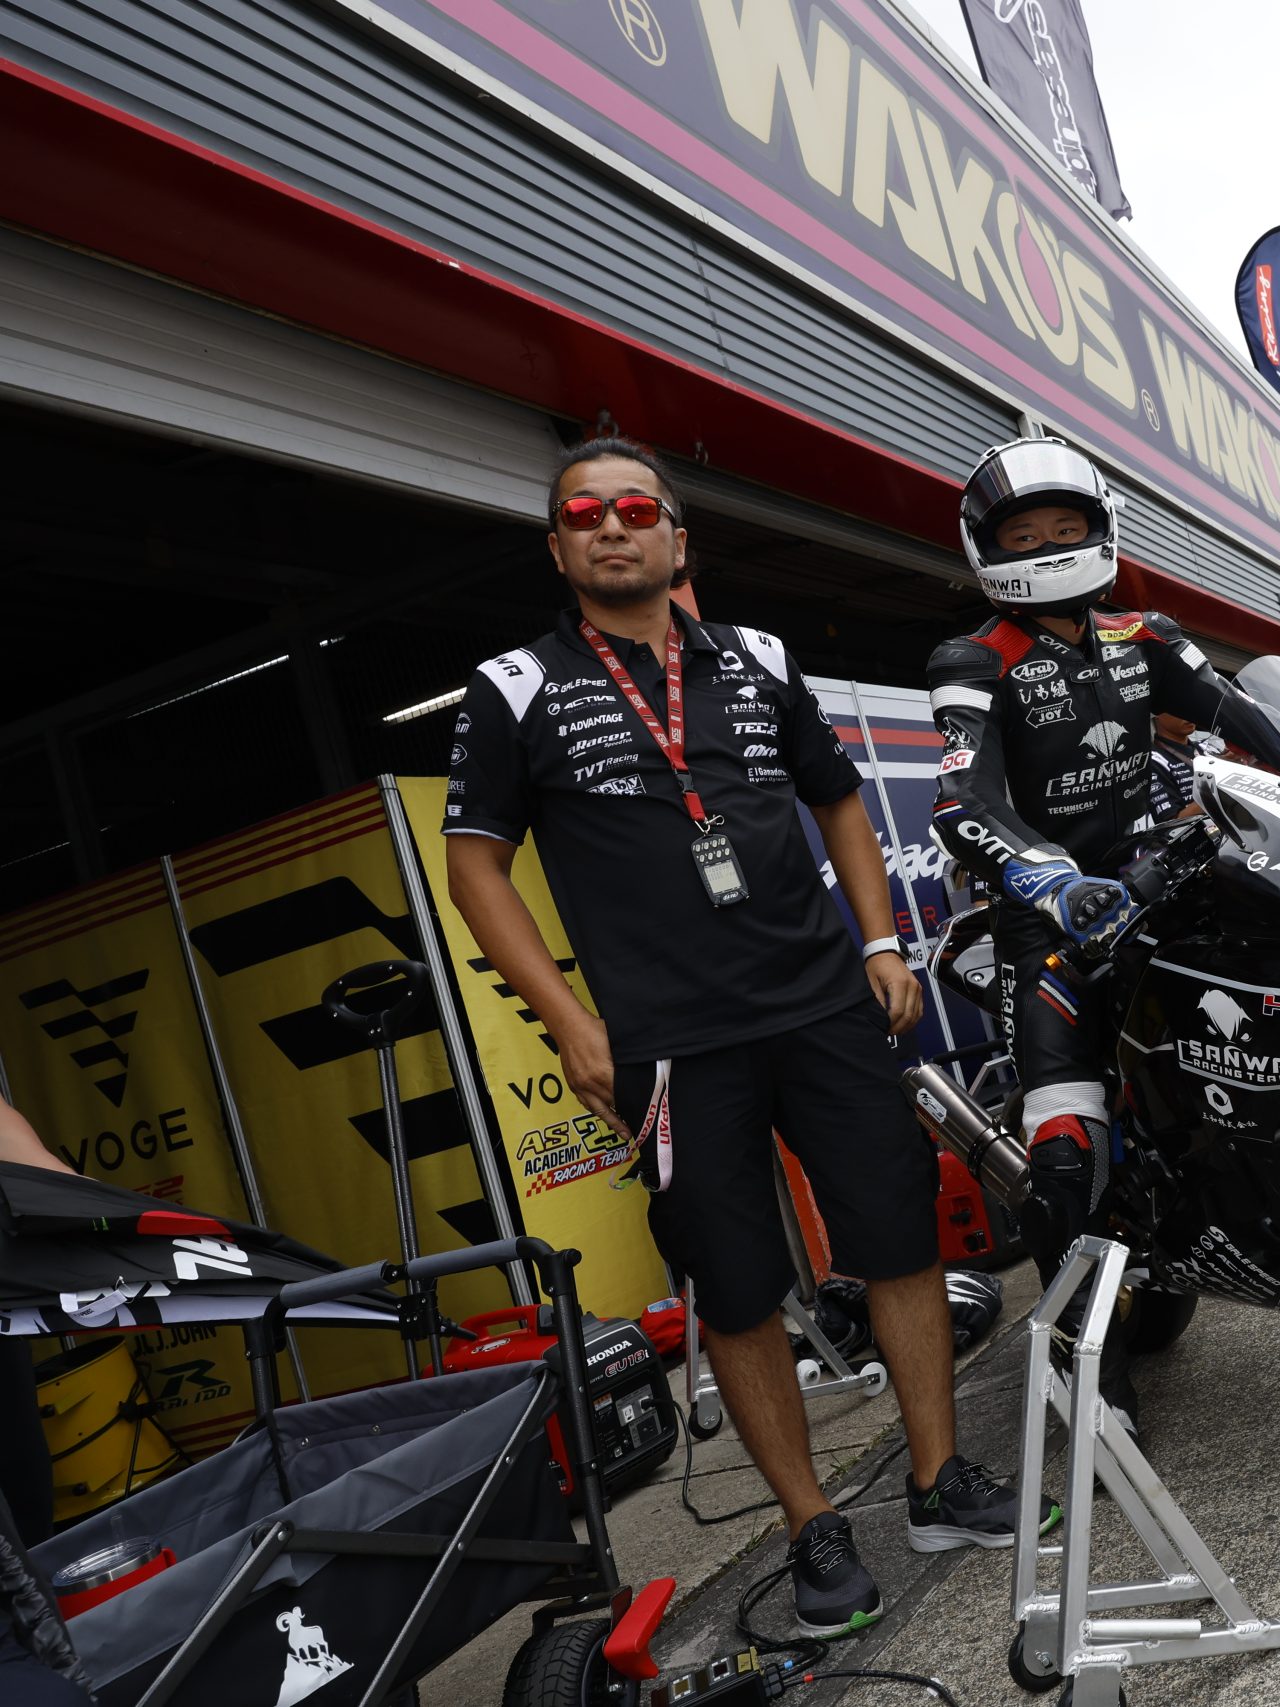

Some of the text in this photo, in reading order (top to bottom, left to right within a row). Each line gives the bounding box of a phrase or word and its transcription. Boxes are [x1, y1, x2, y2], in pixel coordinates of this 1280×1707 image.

[569, 712, 623, 732] ADVANTAGE
[1039, 709, 1062, 722] JOY
[732, 722, 778, 736] TEC.2
[567, 731, 631, 756] aRacer
[606, 753, 639, 767] Racing
[1061, 752, 1144, 787] SANWA
[1193, 1058, 1243, 1079] RACING
[507, 1073, 563, 1110] VO
[59, 1107, 194, 1175] VOGE
[523, 1144, 582, 1177] ACADEMY
[553, 1158, 597, 1184] RACING
[586, 1340, 632, 1367] HONDA
